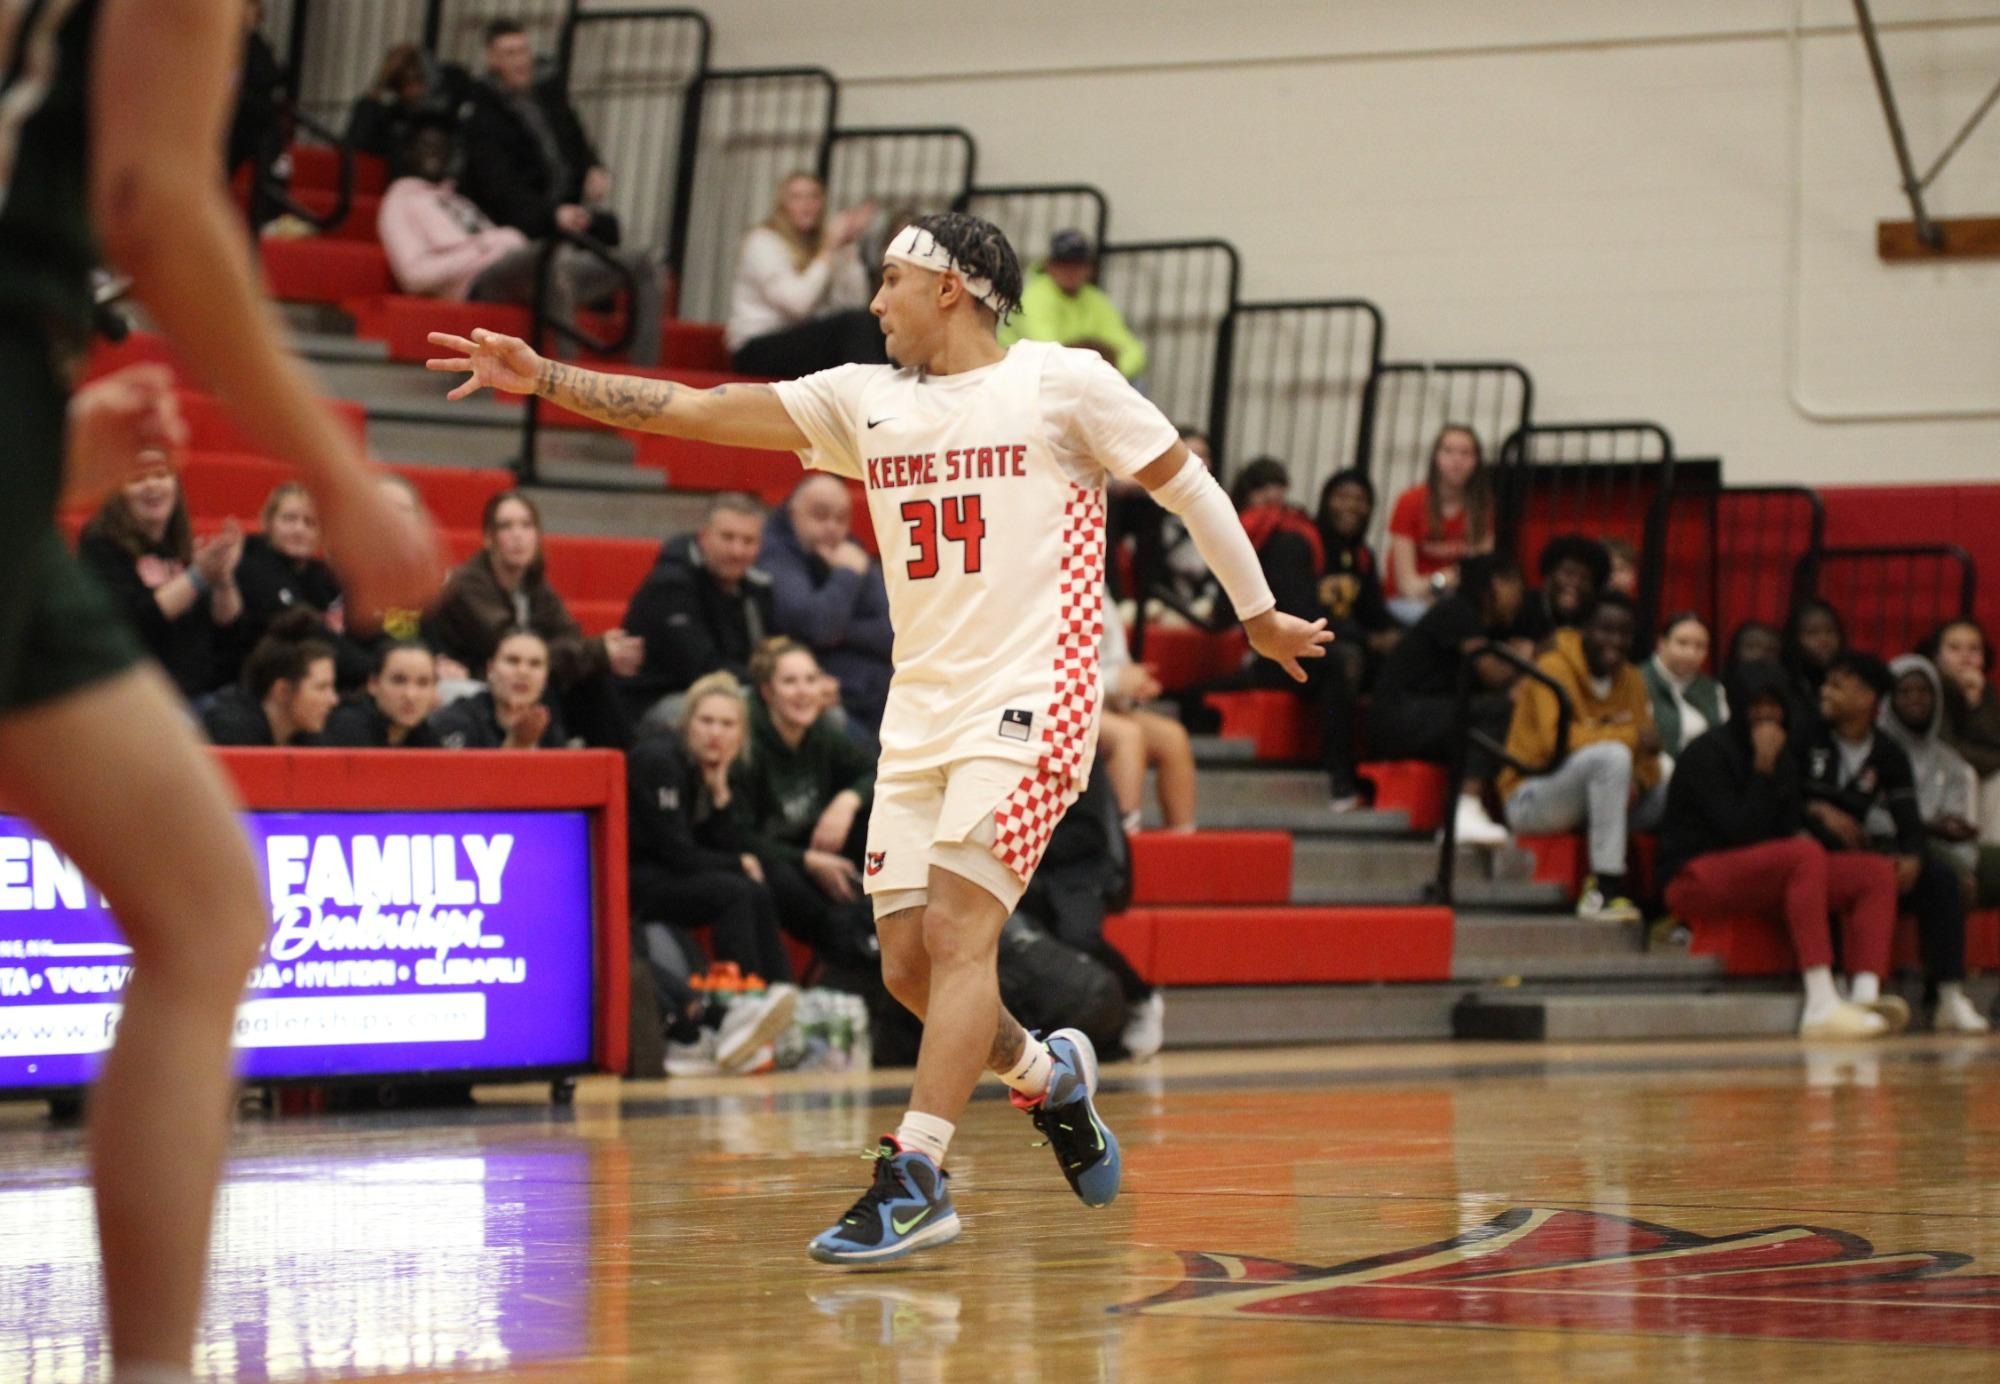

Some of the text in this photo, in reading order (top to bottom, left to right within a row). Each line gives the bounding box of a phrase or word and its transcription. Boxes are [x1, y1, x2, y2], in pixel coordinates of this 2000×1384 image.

[867, 445, 1027, 490] KEENE STATE
[900, 494, 986, 580] 34
[0, 834, 514, 910] EN FAMILY
[45, 965, 136, 994] VOLV
